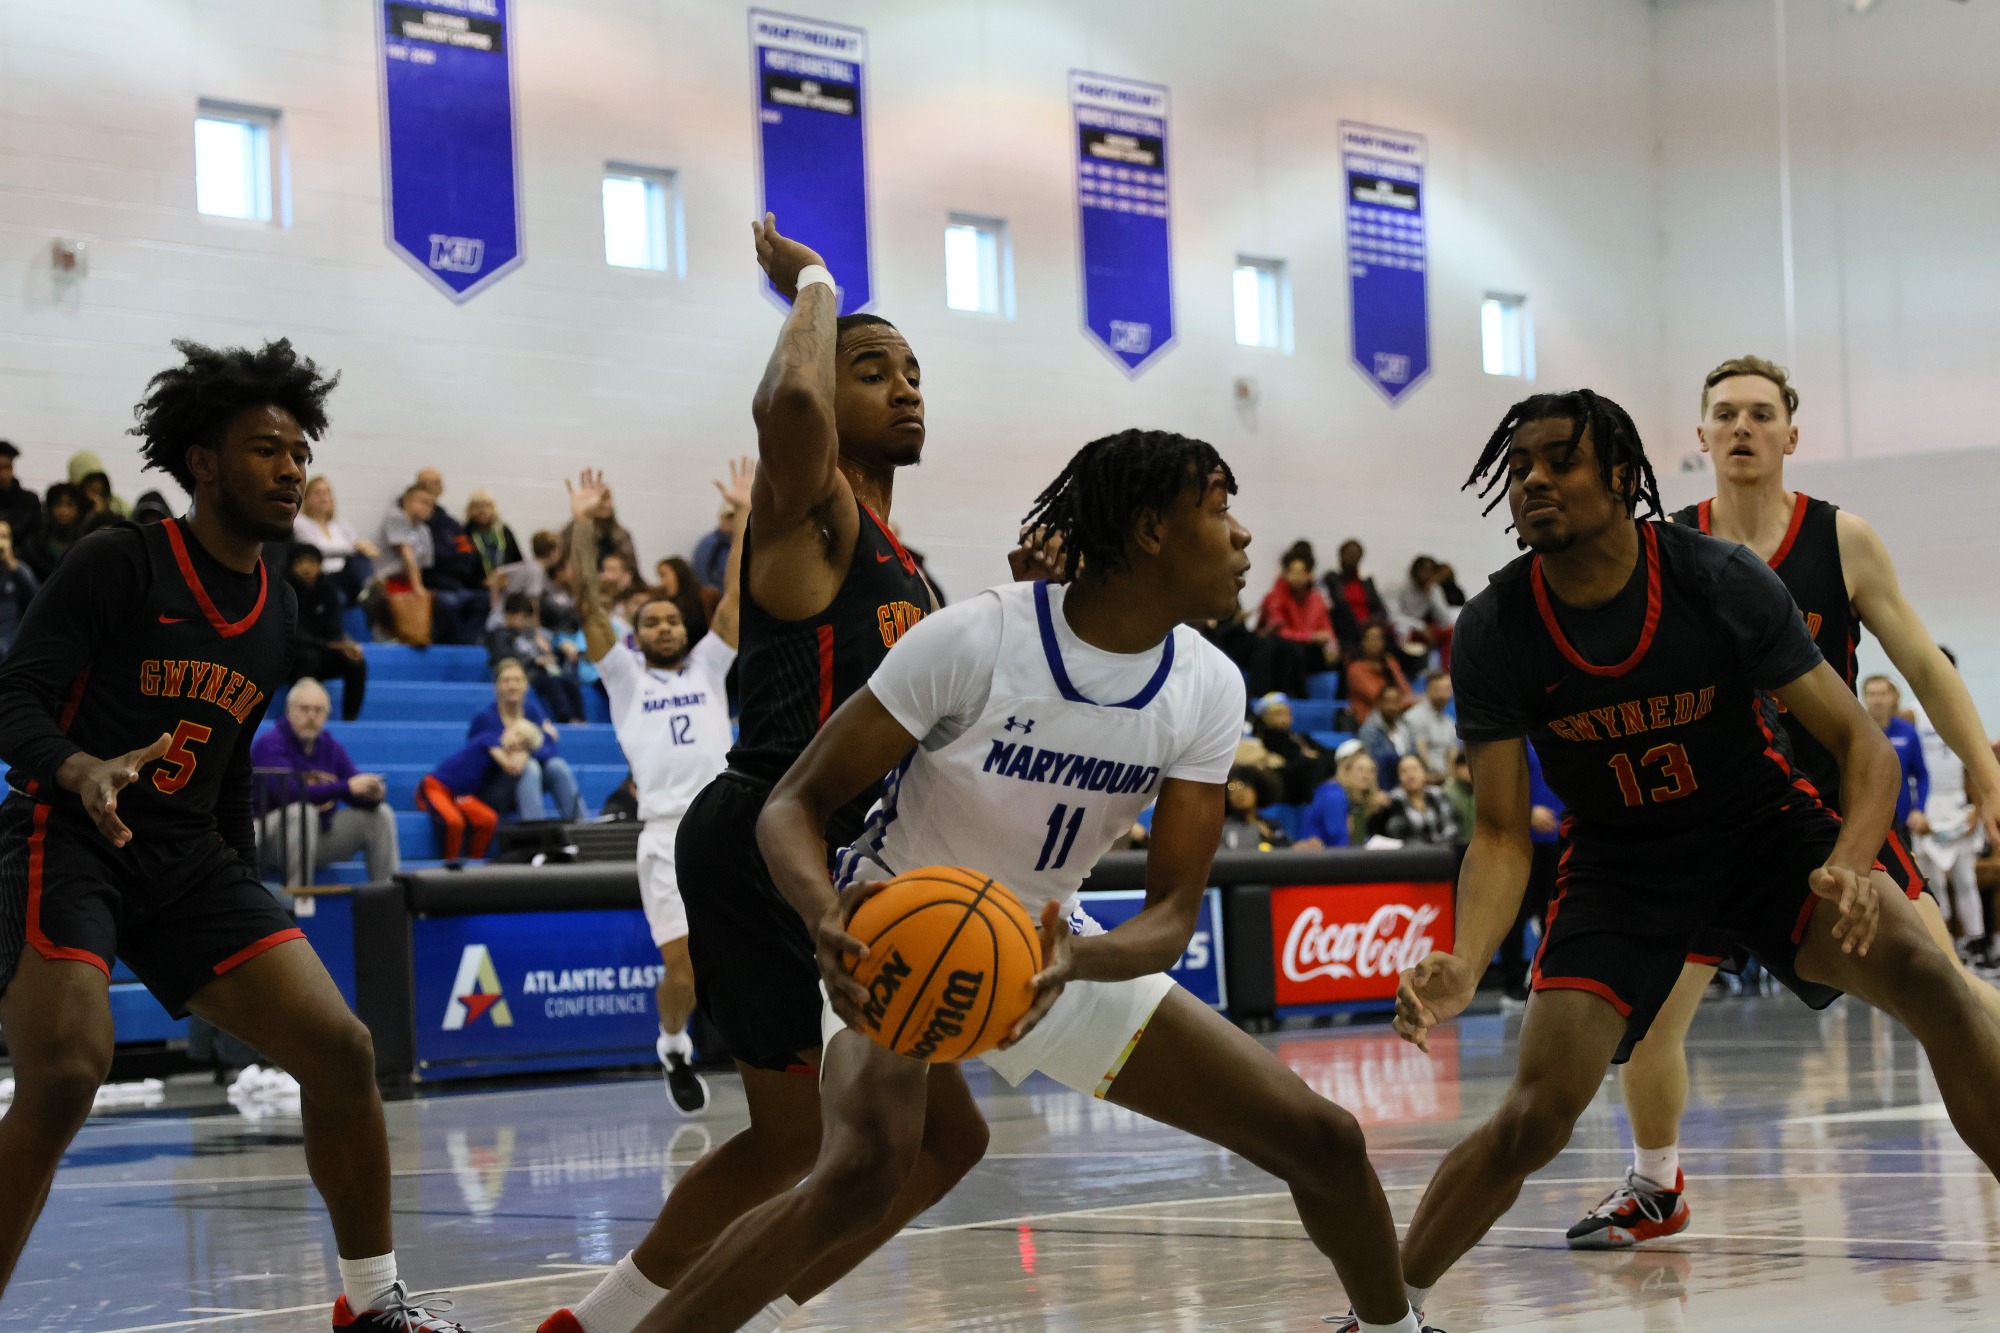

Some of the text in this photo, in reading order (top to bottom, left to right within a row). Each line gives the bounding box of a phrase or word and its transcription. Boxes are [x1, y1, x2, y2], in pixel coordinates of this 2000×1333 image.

[152, 719, 213, 795] 5
[669, 714, 696, 746] 12
[982, 738, 1160, 795] MARYMOUNT
[1607, 742, 1699, 807] 13
[1034, 803, 1086, 872] 11
[1281, 902, 1441, 983] Coca-Cola
[522, 964, 666, 994] ATLANTIC EAST
[544, 992, 648, 1018] CONFERENCE
[904, 968, 985, 1060] Wilson
